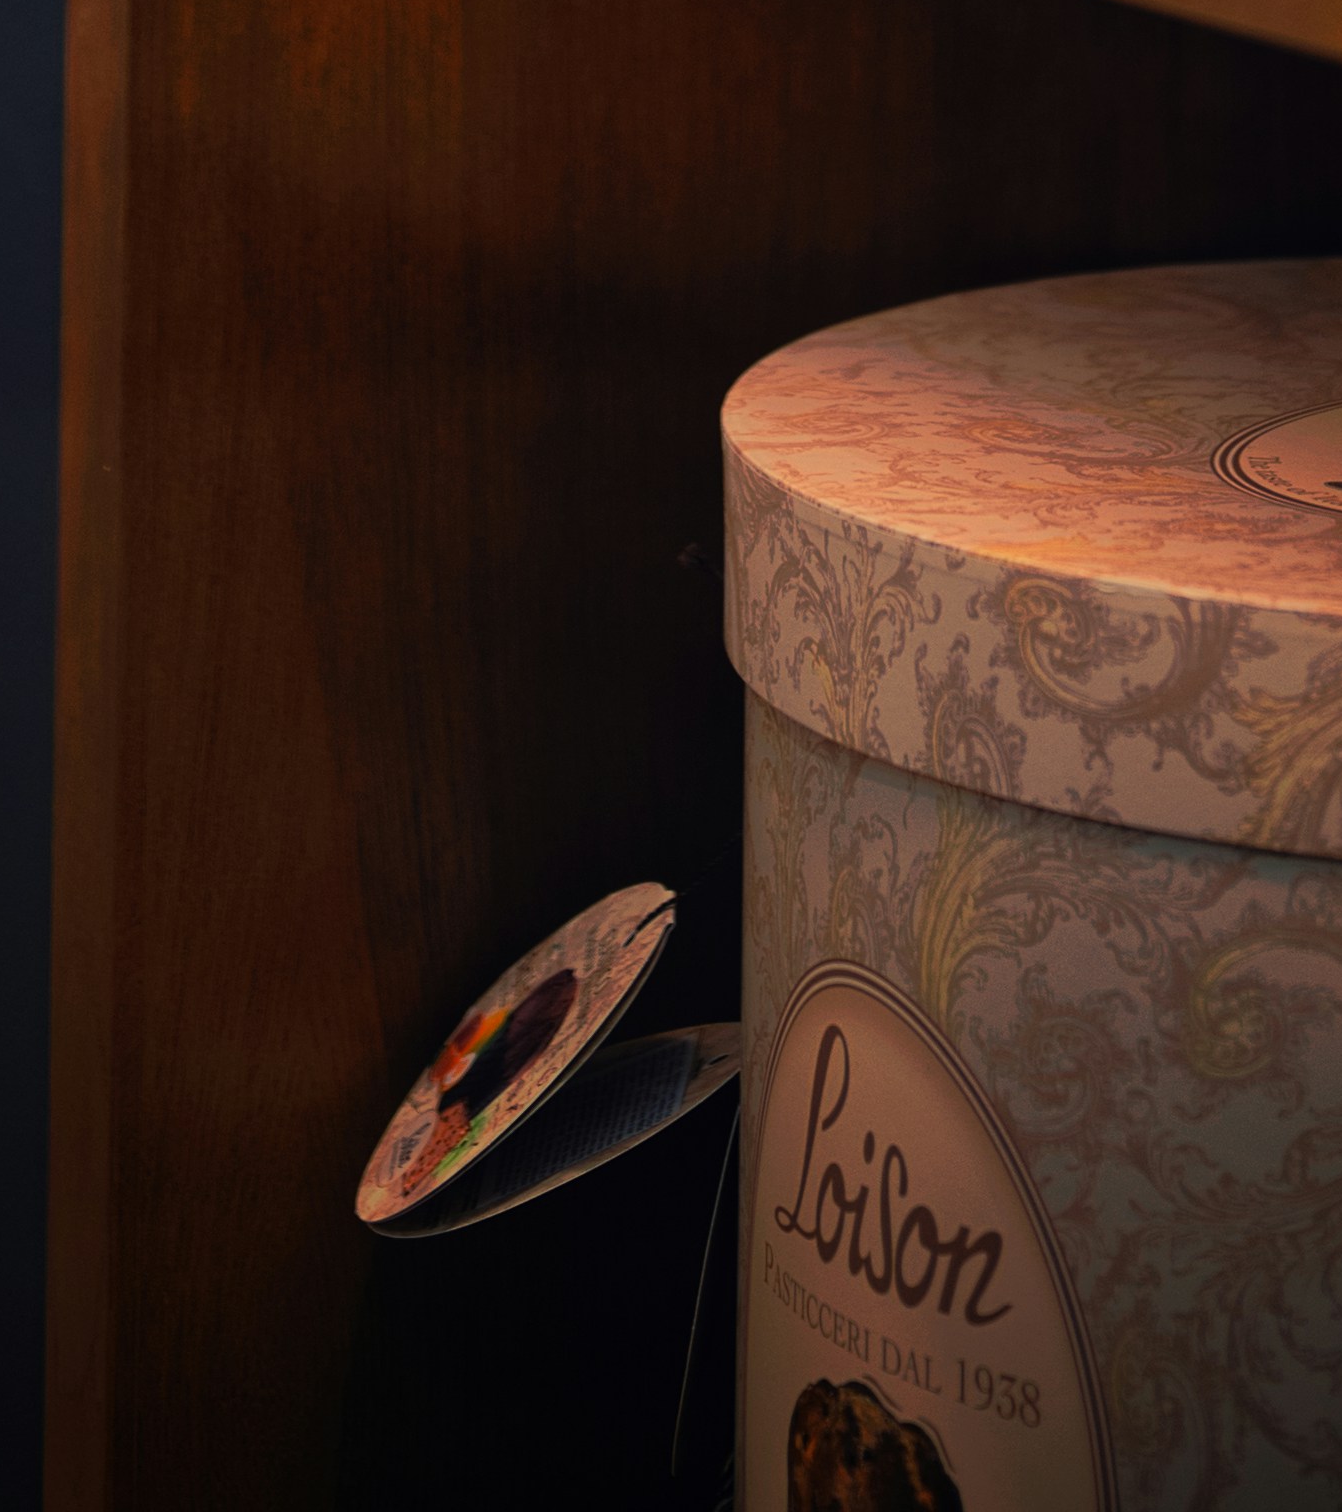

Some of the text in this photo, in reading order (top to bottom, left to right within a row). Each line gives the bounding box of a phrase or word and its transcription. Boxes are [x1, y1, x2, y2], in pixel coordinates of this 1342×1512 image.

[773, 1022, 1014, 1327] Loison
[762, 1240, 1045, 1429] PASTICCERI DAL 1938
